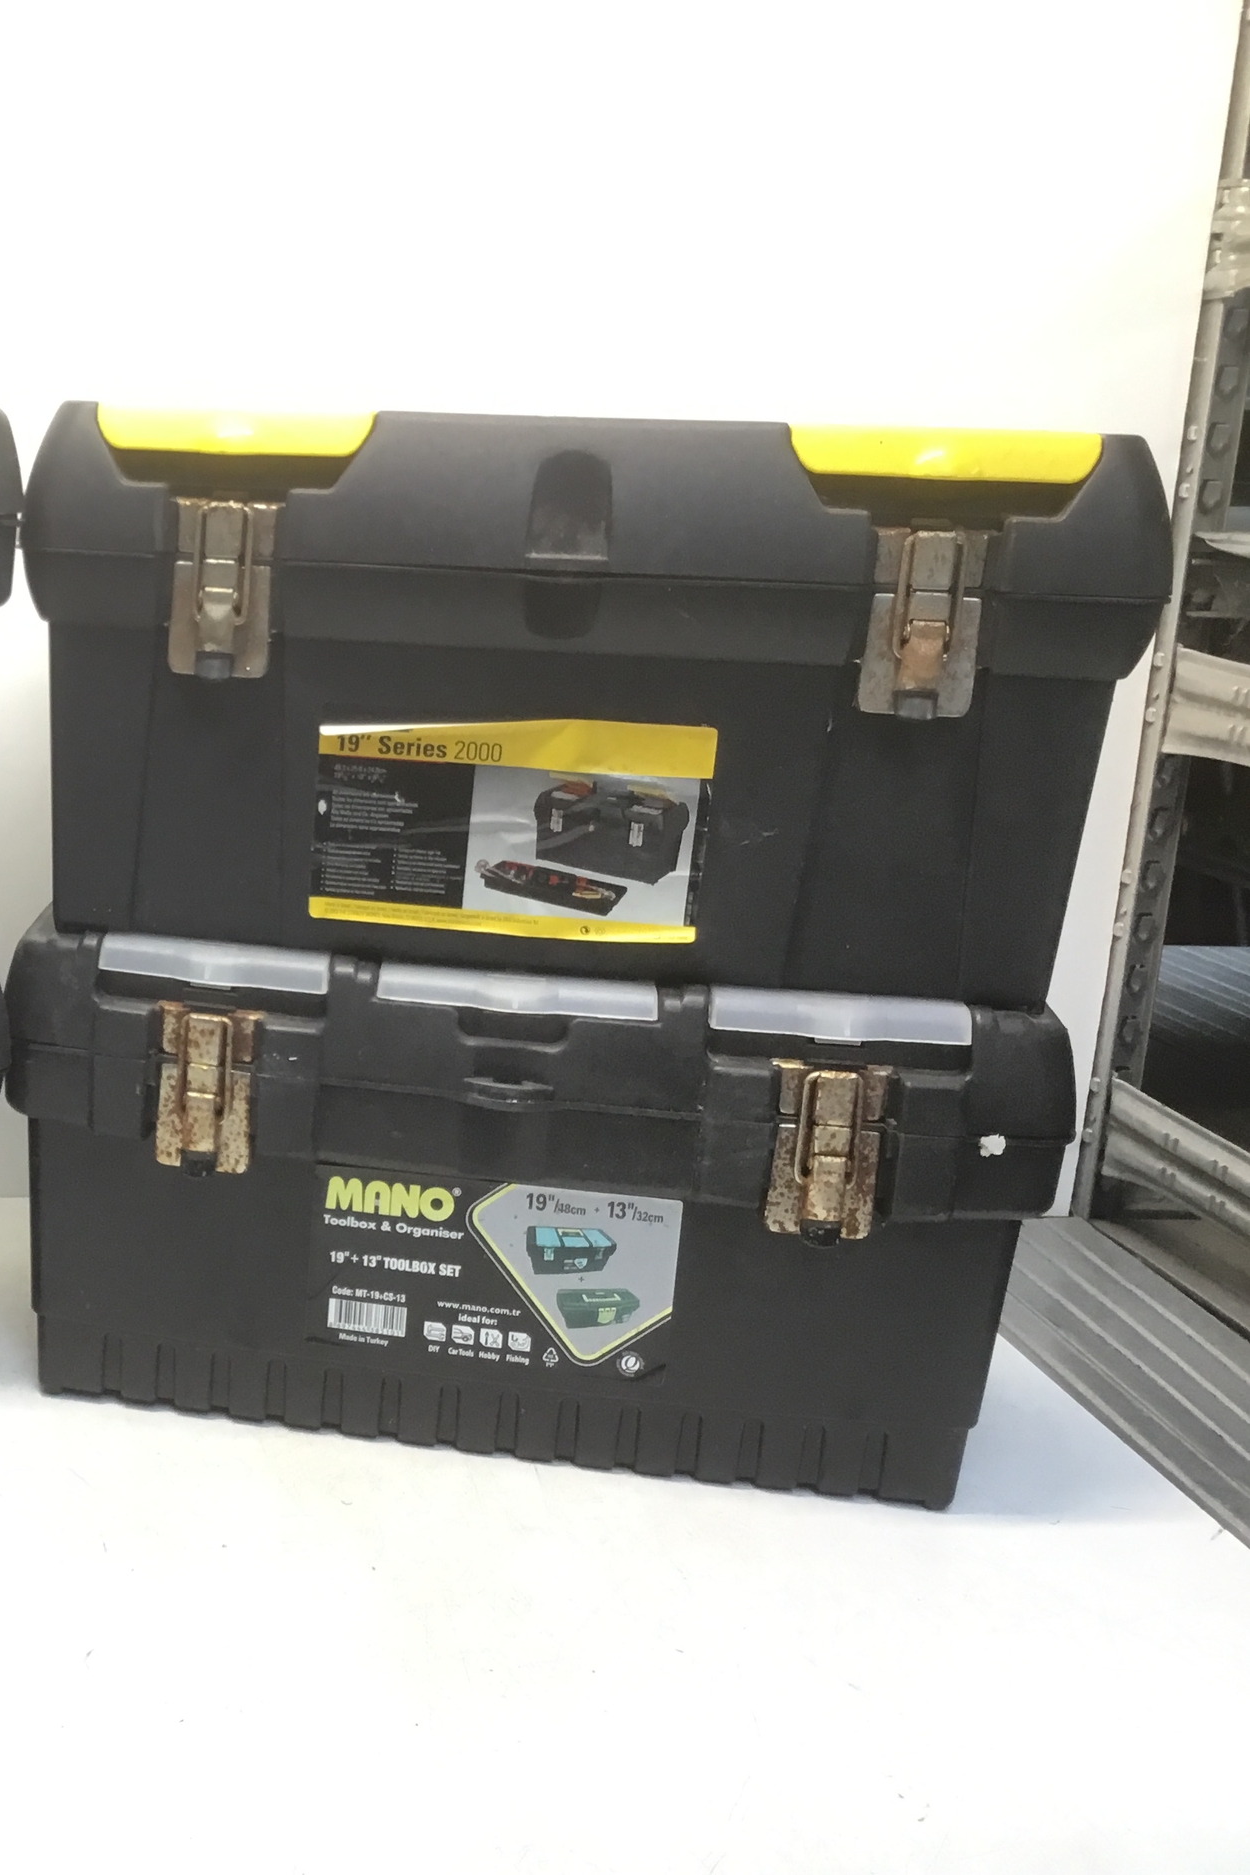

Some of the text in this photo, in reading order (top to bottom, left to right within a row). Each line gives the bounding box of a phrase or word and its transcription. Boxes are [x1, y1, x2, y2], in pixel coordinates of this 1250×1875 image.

[378, 735, 448, 759] Series
[454, 740, 503, 763] 2000
[325, 1175, 455, 1222] MANO
[323, 1214, 464, 1240] Toolbox & Organiser
[383, 1257, 436, 1275] TOOLBOX
[439, 1264, 462, 1278] SET
[332, 1285, 354, 1297] Code:
[437, 1299, 521, 1317] www.mano.com.tr
[458, 1313, 498, 1326] ideal for:
[339, 1333, 358, 1342] Made
[366, 1335, 389, 1347] Turkey
[428, 1344, 440, 1353] DIY
[478, 1350, 500, 1362] Hobby
[506, 1354, 530, 1366] Fishing
